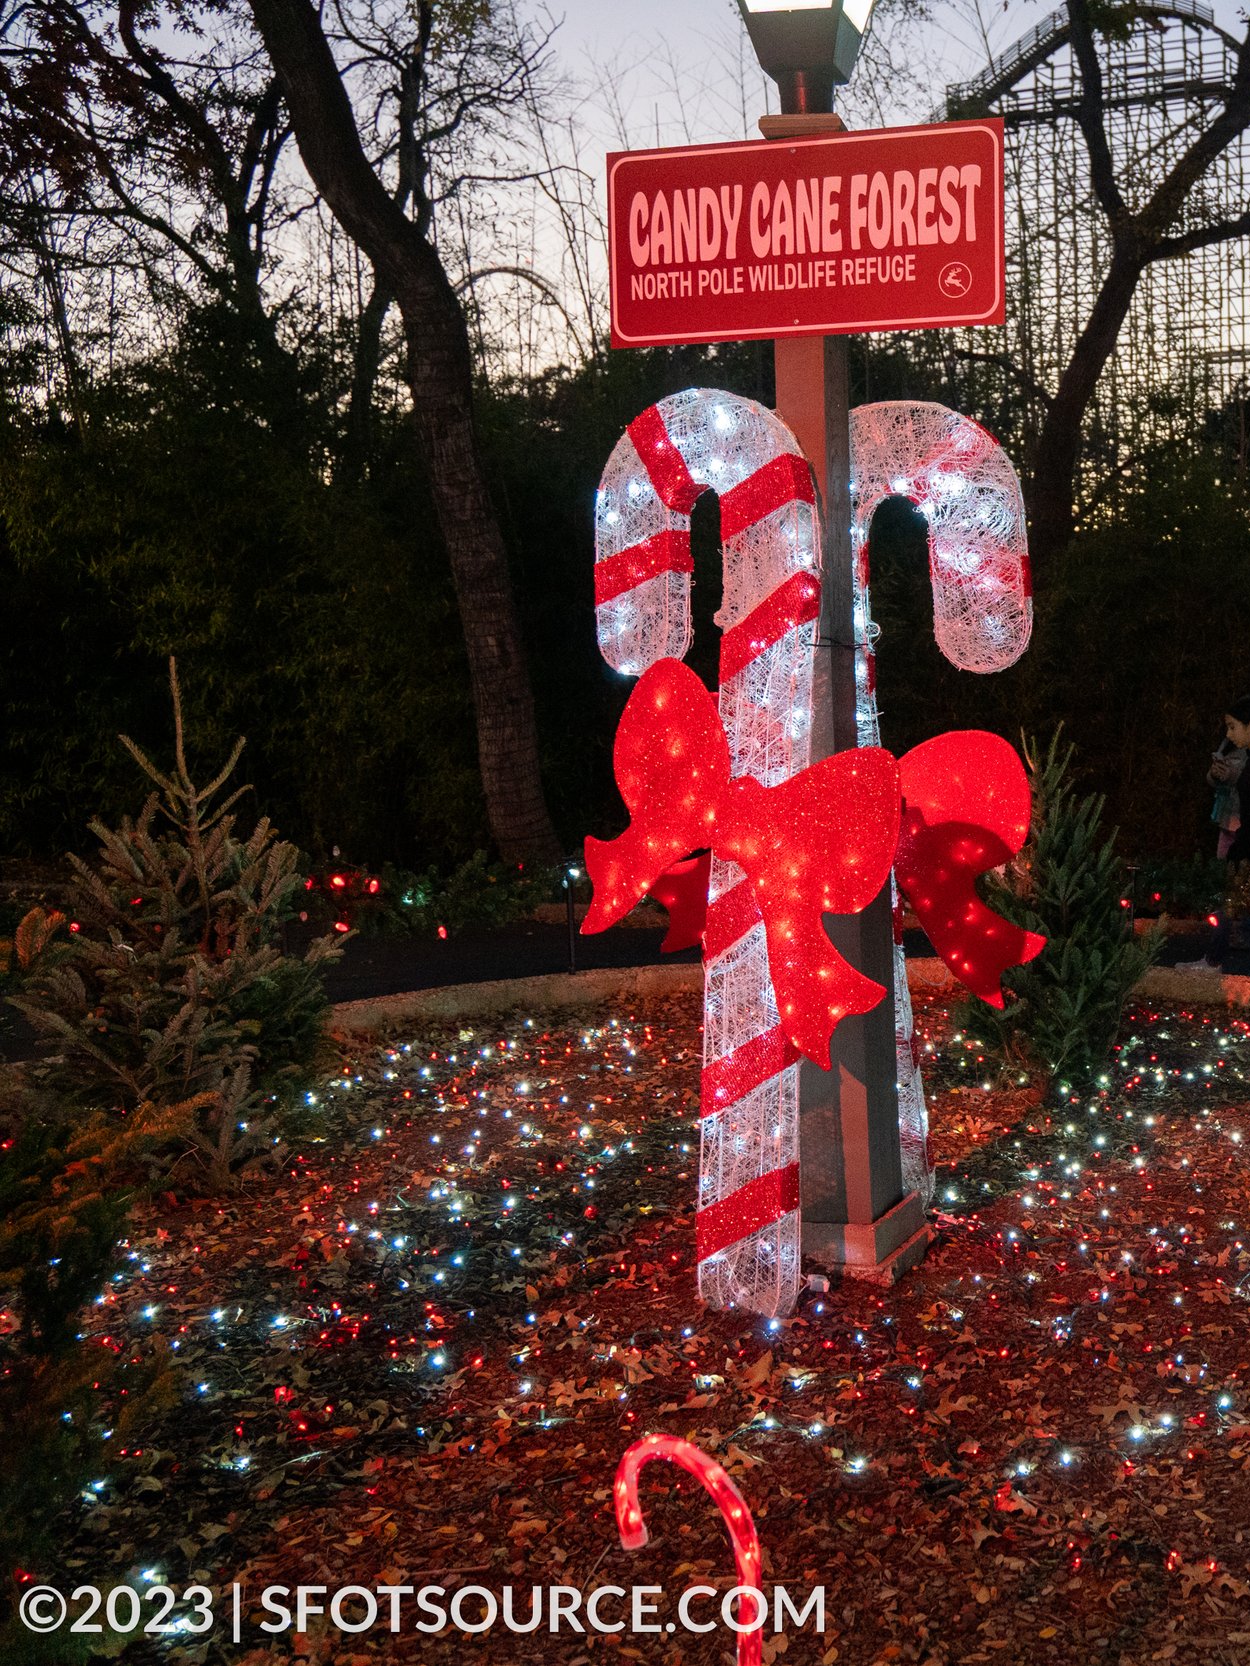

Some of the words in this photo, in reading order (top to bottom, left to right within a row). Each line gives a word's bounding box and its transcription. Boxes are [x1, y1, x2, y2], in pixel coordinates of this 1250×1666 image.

[629, 184, 743, 267] CANDY
[750, 176, 843, 258] CANE
[850, 164, 981, 250] FOREST
[631, 270, 693, 301] NORTH
[698, 266, 745, 296] POLE
[748, 260, 836, 292] WILDLIFE
[842, 254, 916, 285] REFUGE
